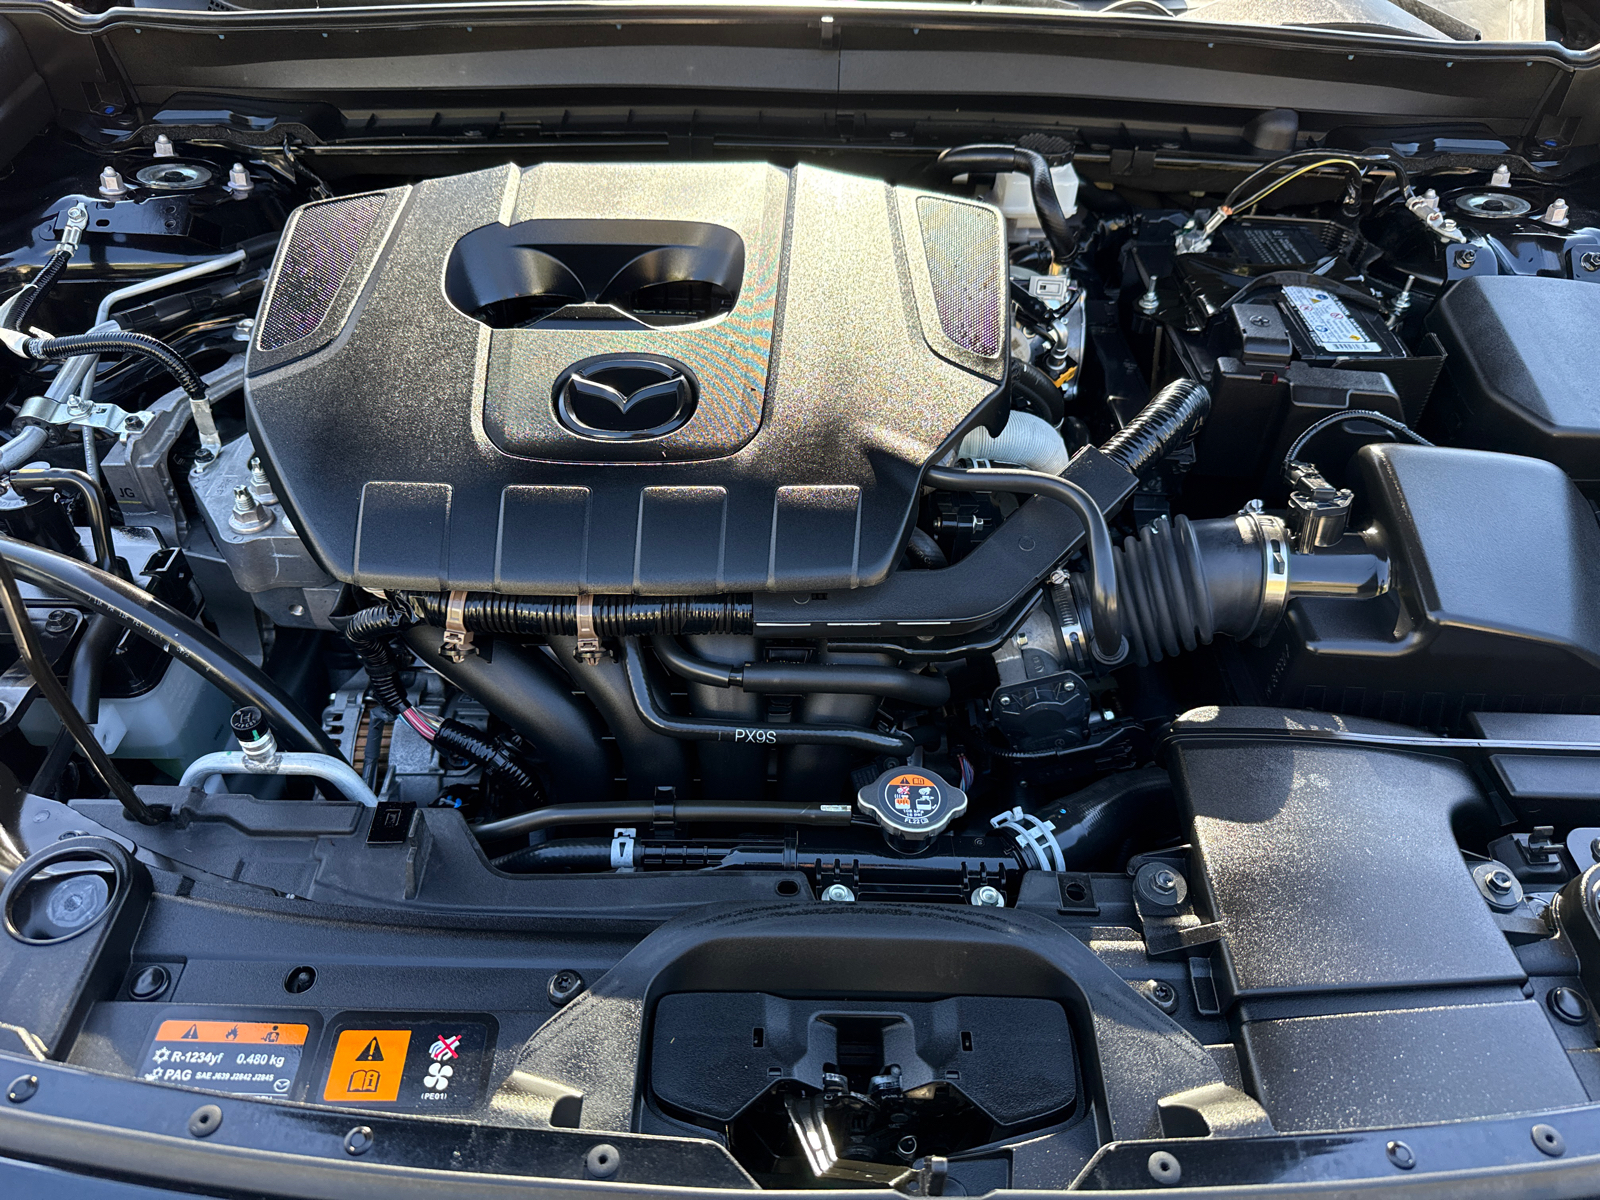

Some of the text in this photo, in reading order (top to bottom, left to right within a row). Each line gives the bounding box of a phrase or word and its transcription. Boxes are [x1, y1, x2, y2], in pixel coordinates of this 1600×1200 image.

[119, 487, 135, 498] JG
[735, 729, 777, 744] PX9S
[170, 1051, 285, 1068] R-1234yf 0.480 kg
[163, 1069, 192, 1081] PAG
[195, 1071, 212, 1080] SAE
[421, 1092, 447, 1100] (PE01)
